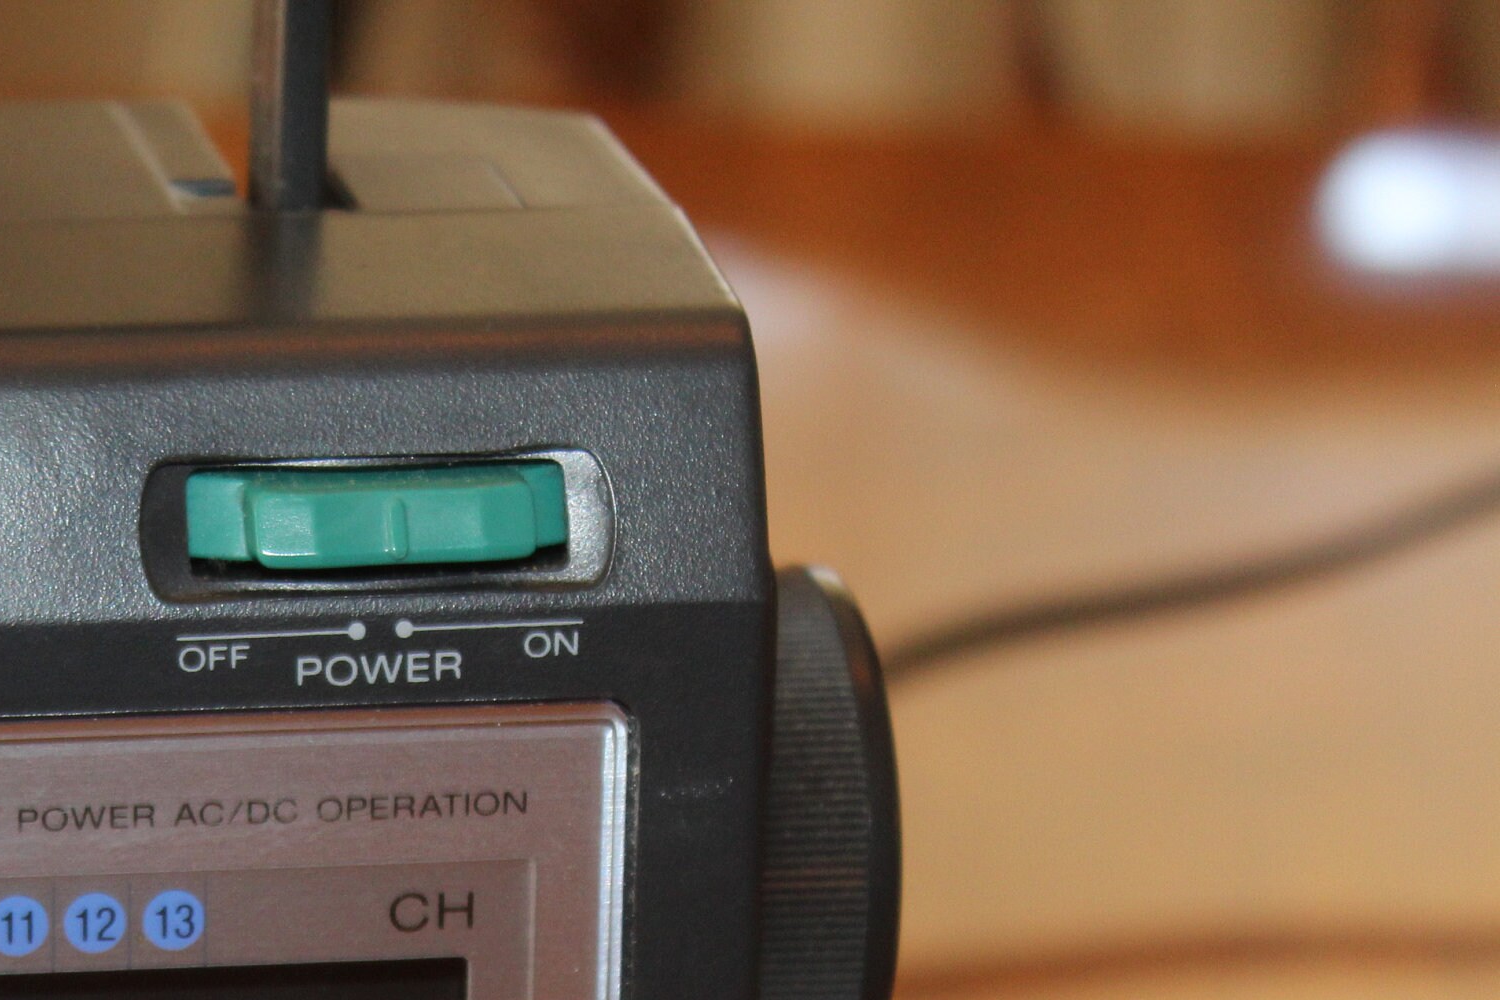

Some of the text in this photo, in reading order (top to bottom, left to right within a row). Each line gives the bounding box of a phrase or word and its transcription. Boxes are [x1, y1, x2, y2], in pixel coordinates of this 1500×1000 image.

[178, 643, 250, 673] OFF
[523, 630, 580, 659] ON
[296, 650, 463, 686] POWER
[17, 804, 155, 833] POWER
[175, 799, 298, 827] AC/DC
[316, 790, 529, 823] OPERATION
[1, 909, 36, 945] 11
[74, 906, 118, 943] 12
[155, 904, 196, 940] 13
[389, 890, 474, 933] CH
